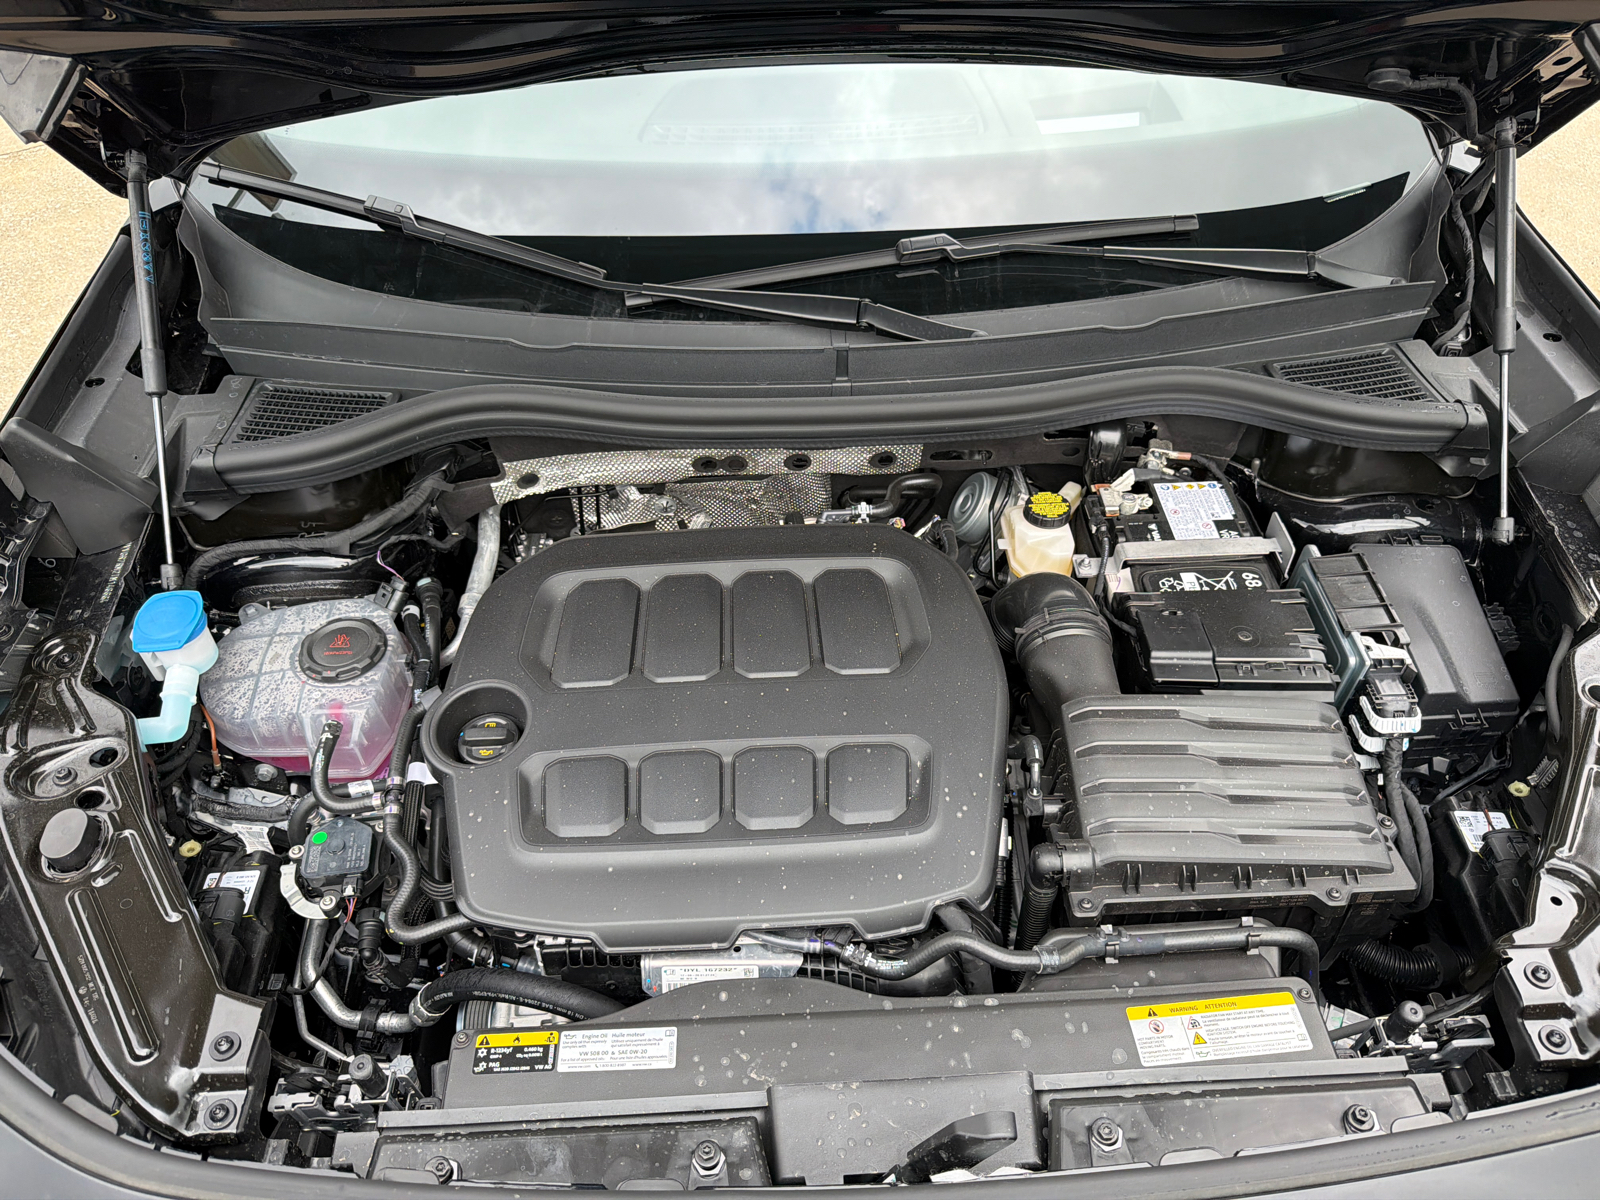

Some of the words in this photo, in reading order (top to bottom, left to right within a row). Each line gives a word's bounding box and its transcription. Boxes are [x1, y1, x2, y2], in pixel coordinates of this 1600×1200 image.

[1242, 572, 1262, 590] 68
[1169, 1005, 1198, 1013] WARNING
[1204, 1002, 1238, 1010] ATTENTION
